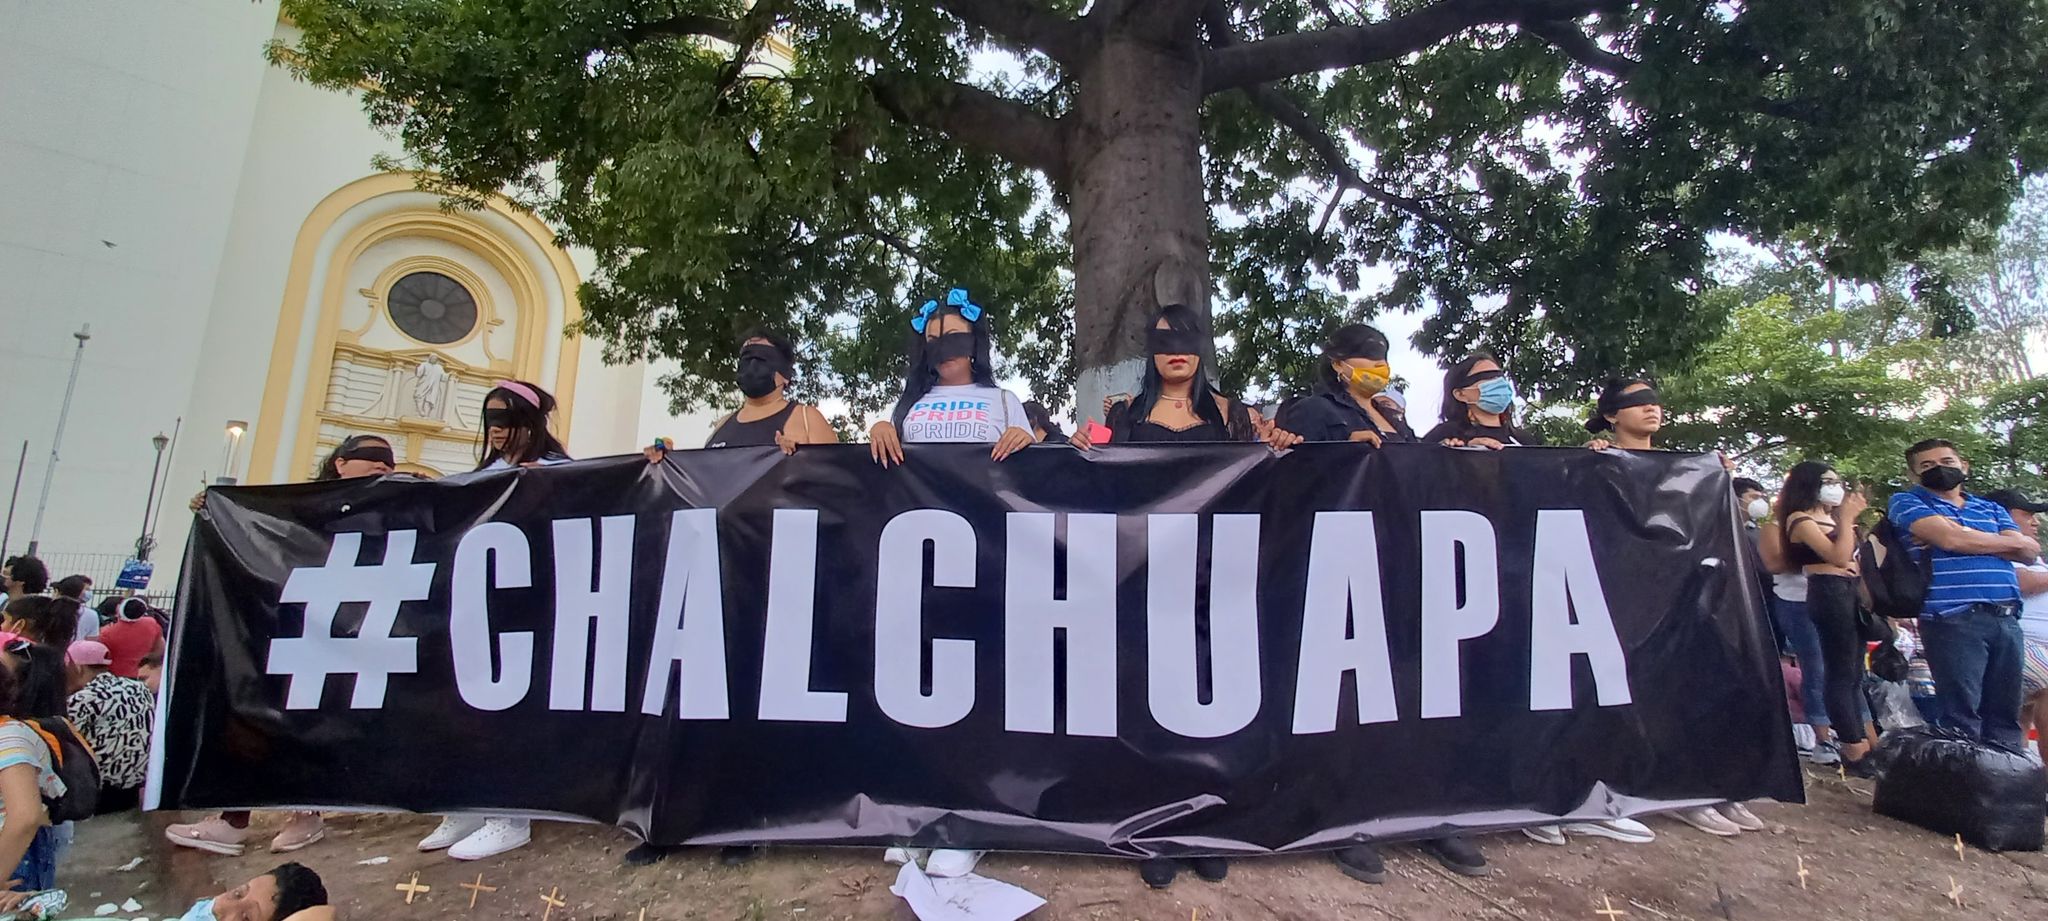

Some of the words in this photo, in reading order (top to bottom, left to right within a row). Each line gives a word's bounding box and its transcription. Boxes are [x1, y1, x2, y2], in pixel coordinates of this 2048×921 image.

[914, 401, 991, 411] PRIDE
[909, 411, 990, 423] PRIDE
[909, 422, 989, 440] PRIDE
[266, 508, 1632, 738] #CHALCHUAPA
